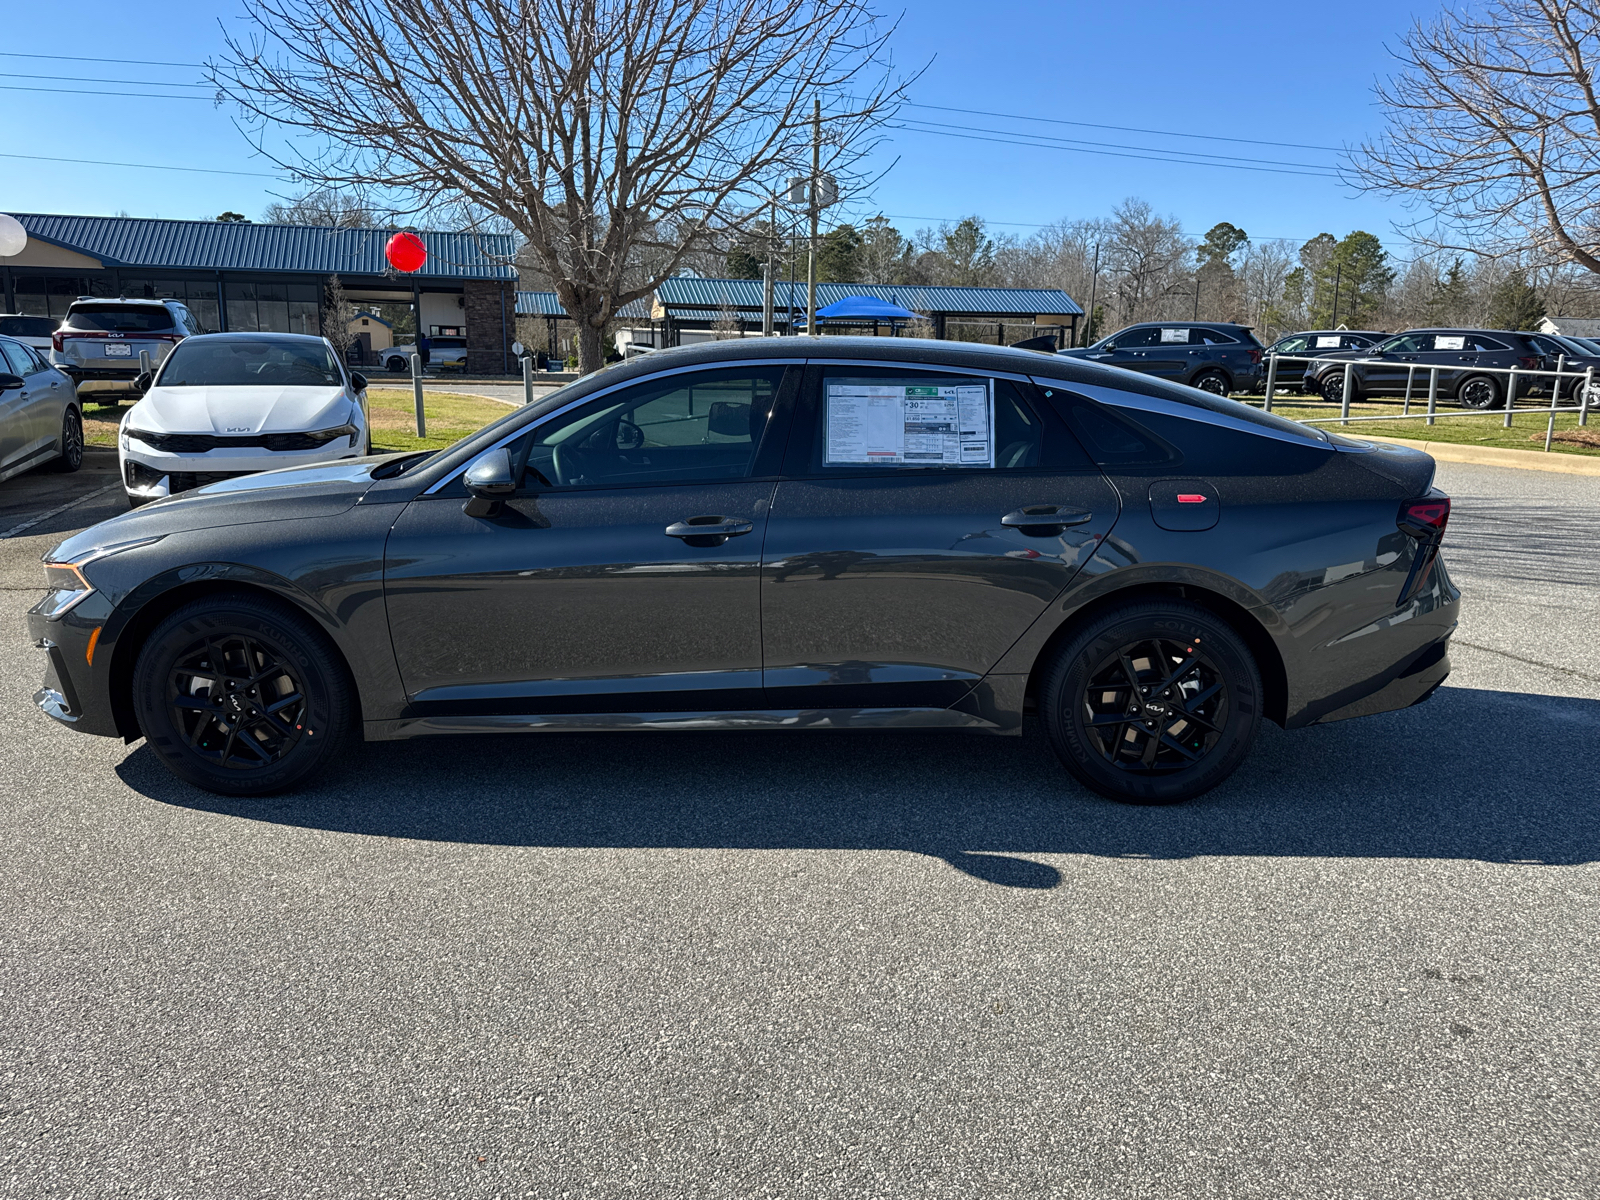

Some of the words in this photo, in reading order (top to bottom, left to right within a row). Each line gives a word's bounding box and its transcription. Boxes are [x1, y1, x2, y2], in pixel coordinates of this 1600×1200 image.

[909, 401, 919, 409] 30
[1153, 620, 1213, 642] SOLUS
[258, 623, 309, 668] KUMHO
[1145, 703, 1165, 713] KIA
[1063, 707, 1089, 764] KUMHO
[229, 769, 287, 789] SOLUS
